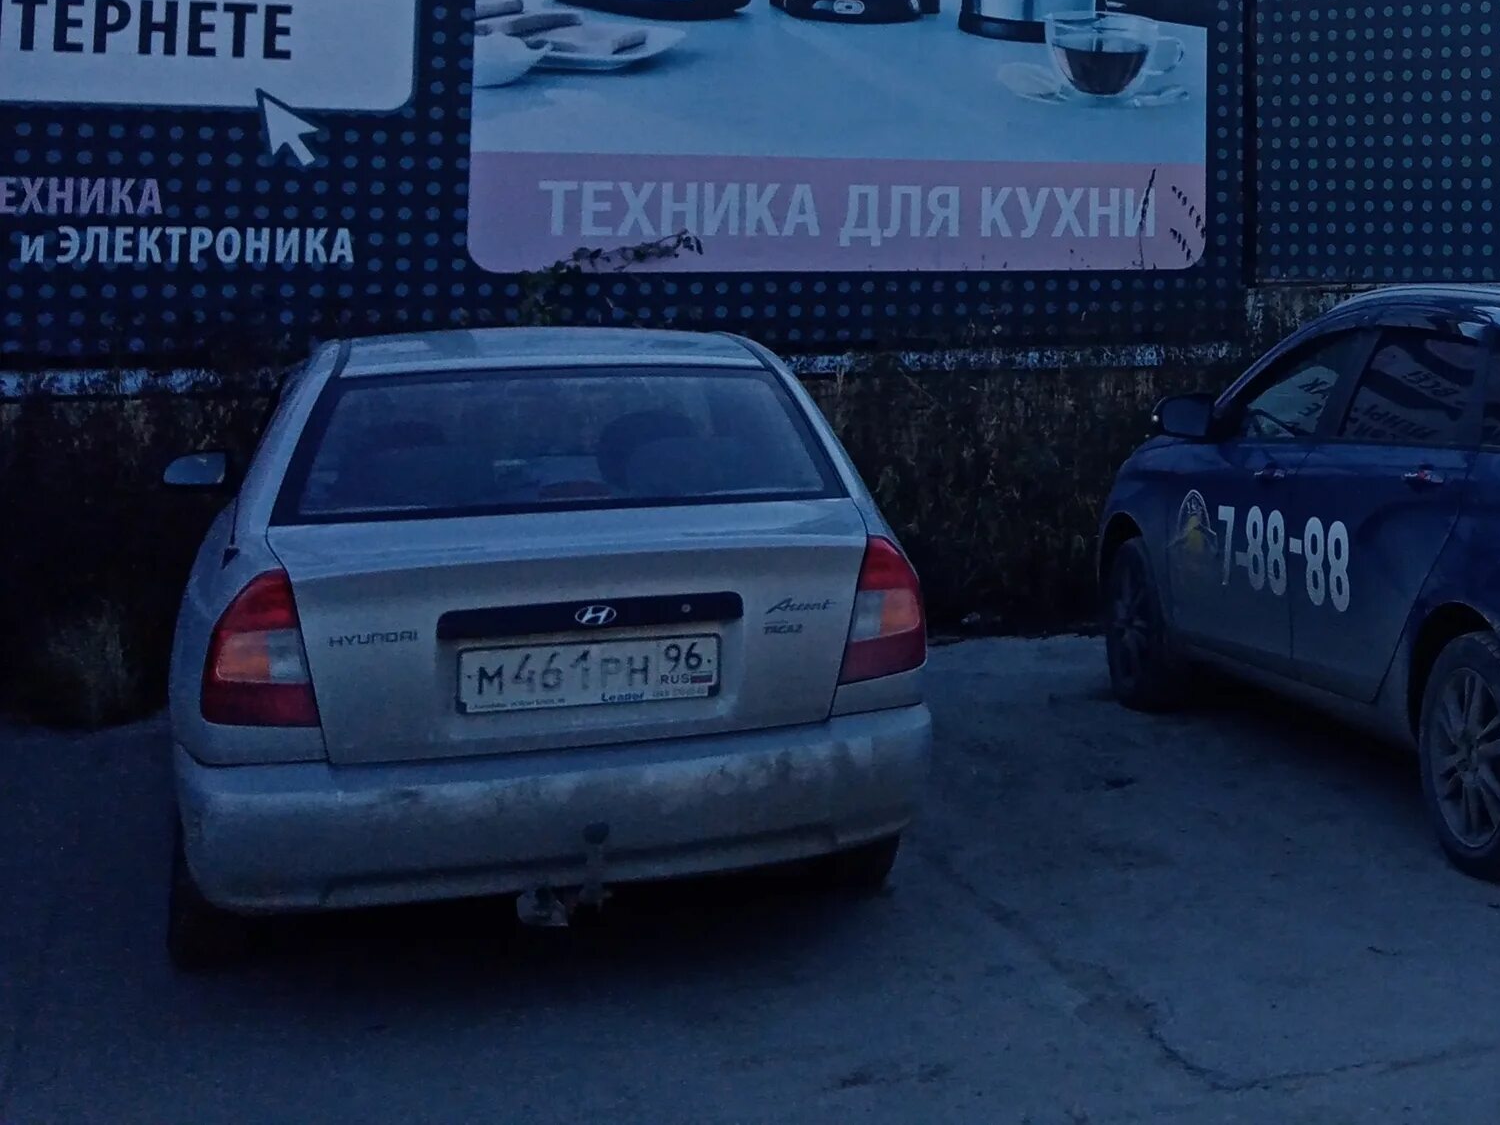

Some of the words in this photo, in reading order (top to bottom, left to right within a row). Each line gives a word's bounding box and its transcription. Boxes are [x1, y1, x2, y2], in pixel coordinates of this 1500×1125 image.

[539, 179, 821, 238] ТЕХНИКА
[840, 183, 960, 246] ДЛЯ
[980, 185, 1157, 240] КУХНИ
[19, 236, 44, 264] и
[56, 225, 356, 266] ЭЛЕКТРОНИКА
[1217, 505, 1350, 613] 7-88-88
[328, 629, 419, 648] HYUNDAI
[664, 642, 703, 672] 96
[660, 673, 690, 685] RUS
